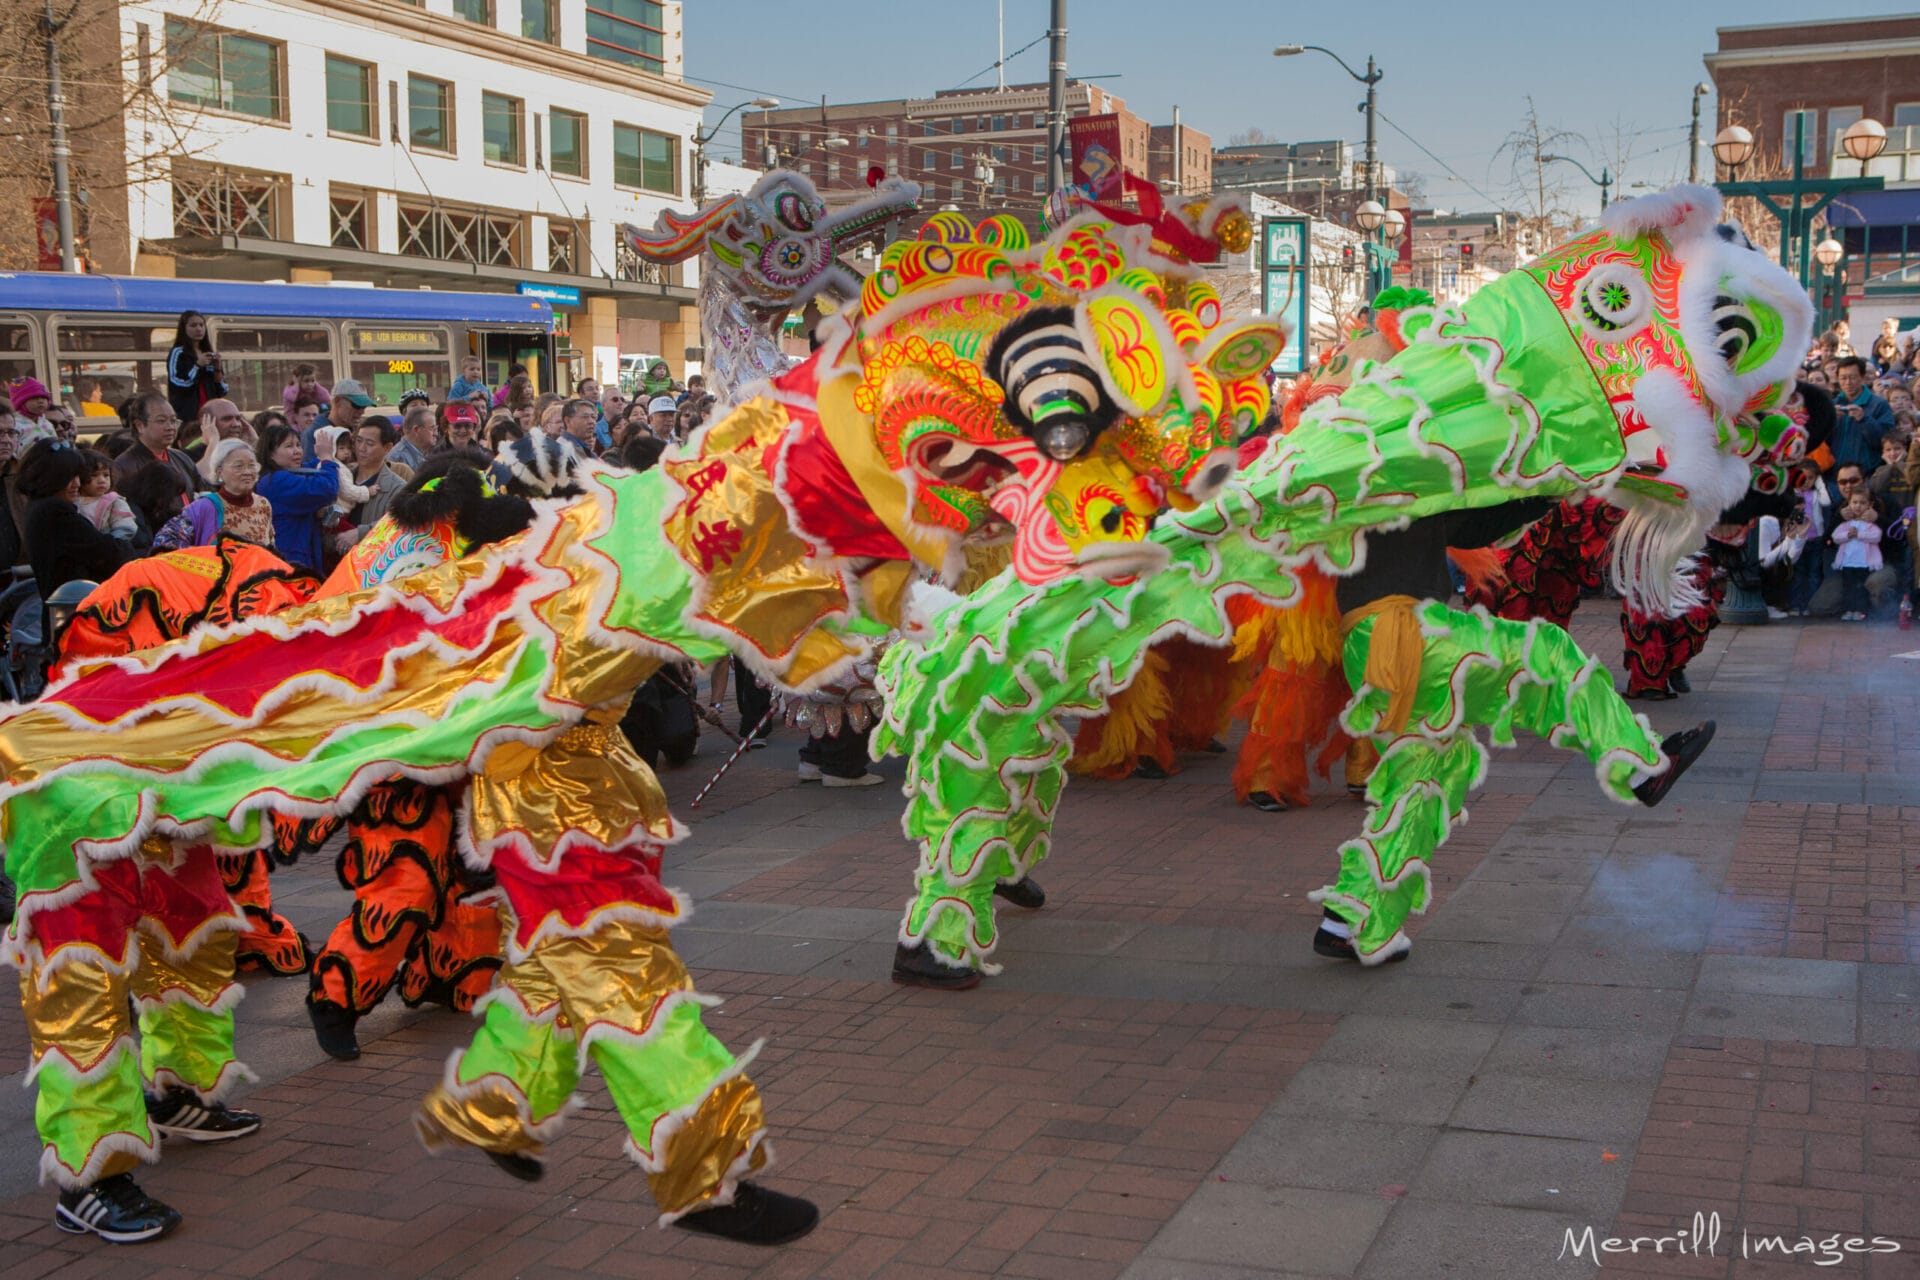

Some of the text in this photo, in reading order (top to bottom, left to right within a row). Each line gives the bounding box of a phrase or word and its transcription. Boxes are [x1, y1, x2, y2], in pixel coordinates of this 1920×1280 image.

[1072, 120, 1118, 132] CHINATOWN
[1271, 274, 1299, 284] Meto
[361, 332, 372, 342] 36
[391, 332, 416, 342] BEACON
[388, 360, 414, 373] 2460
